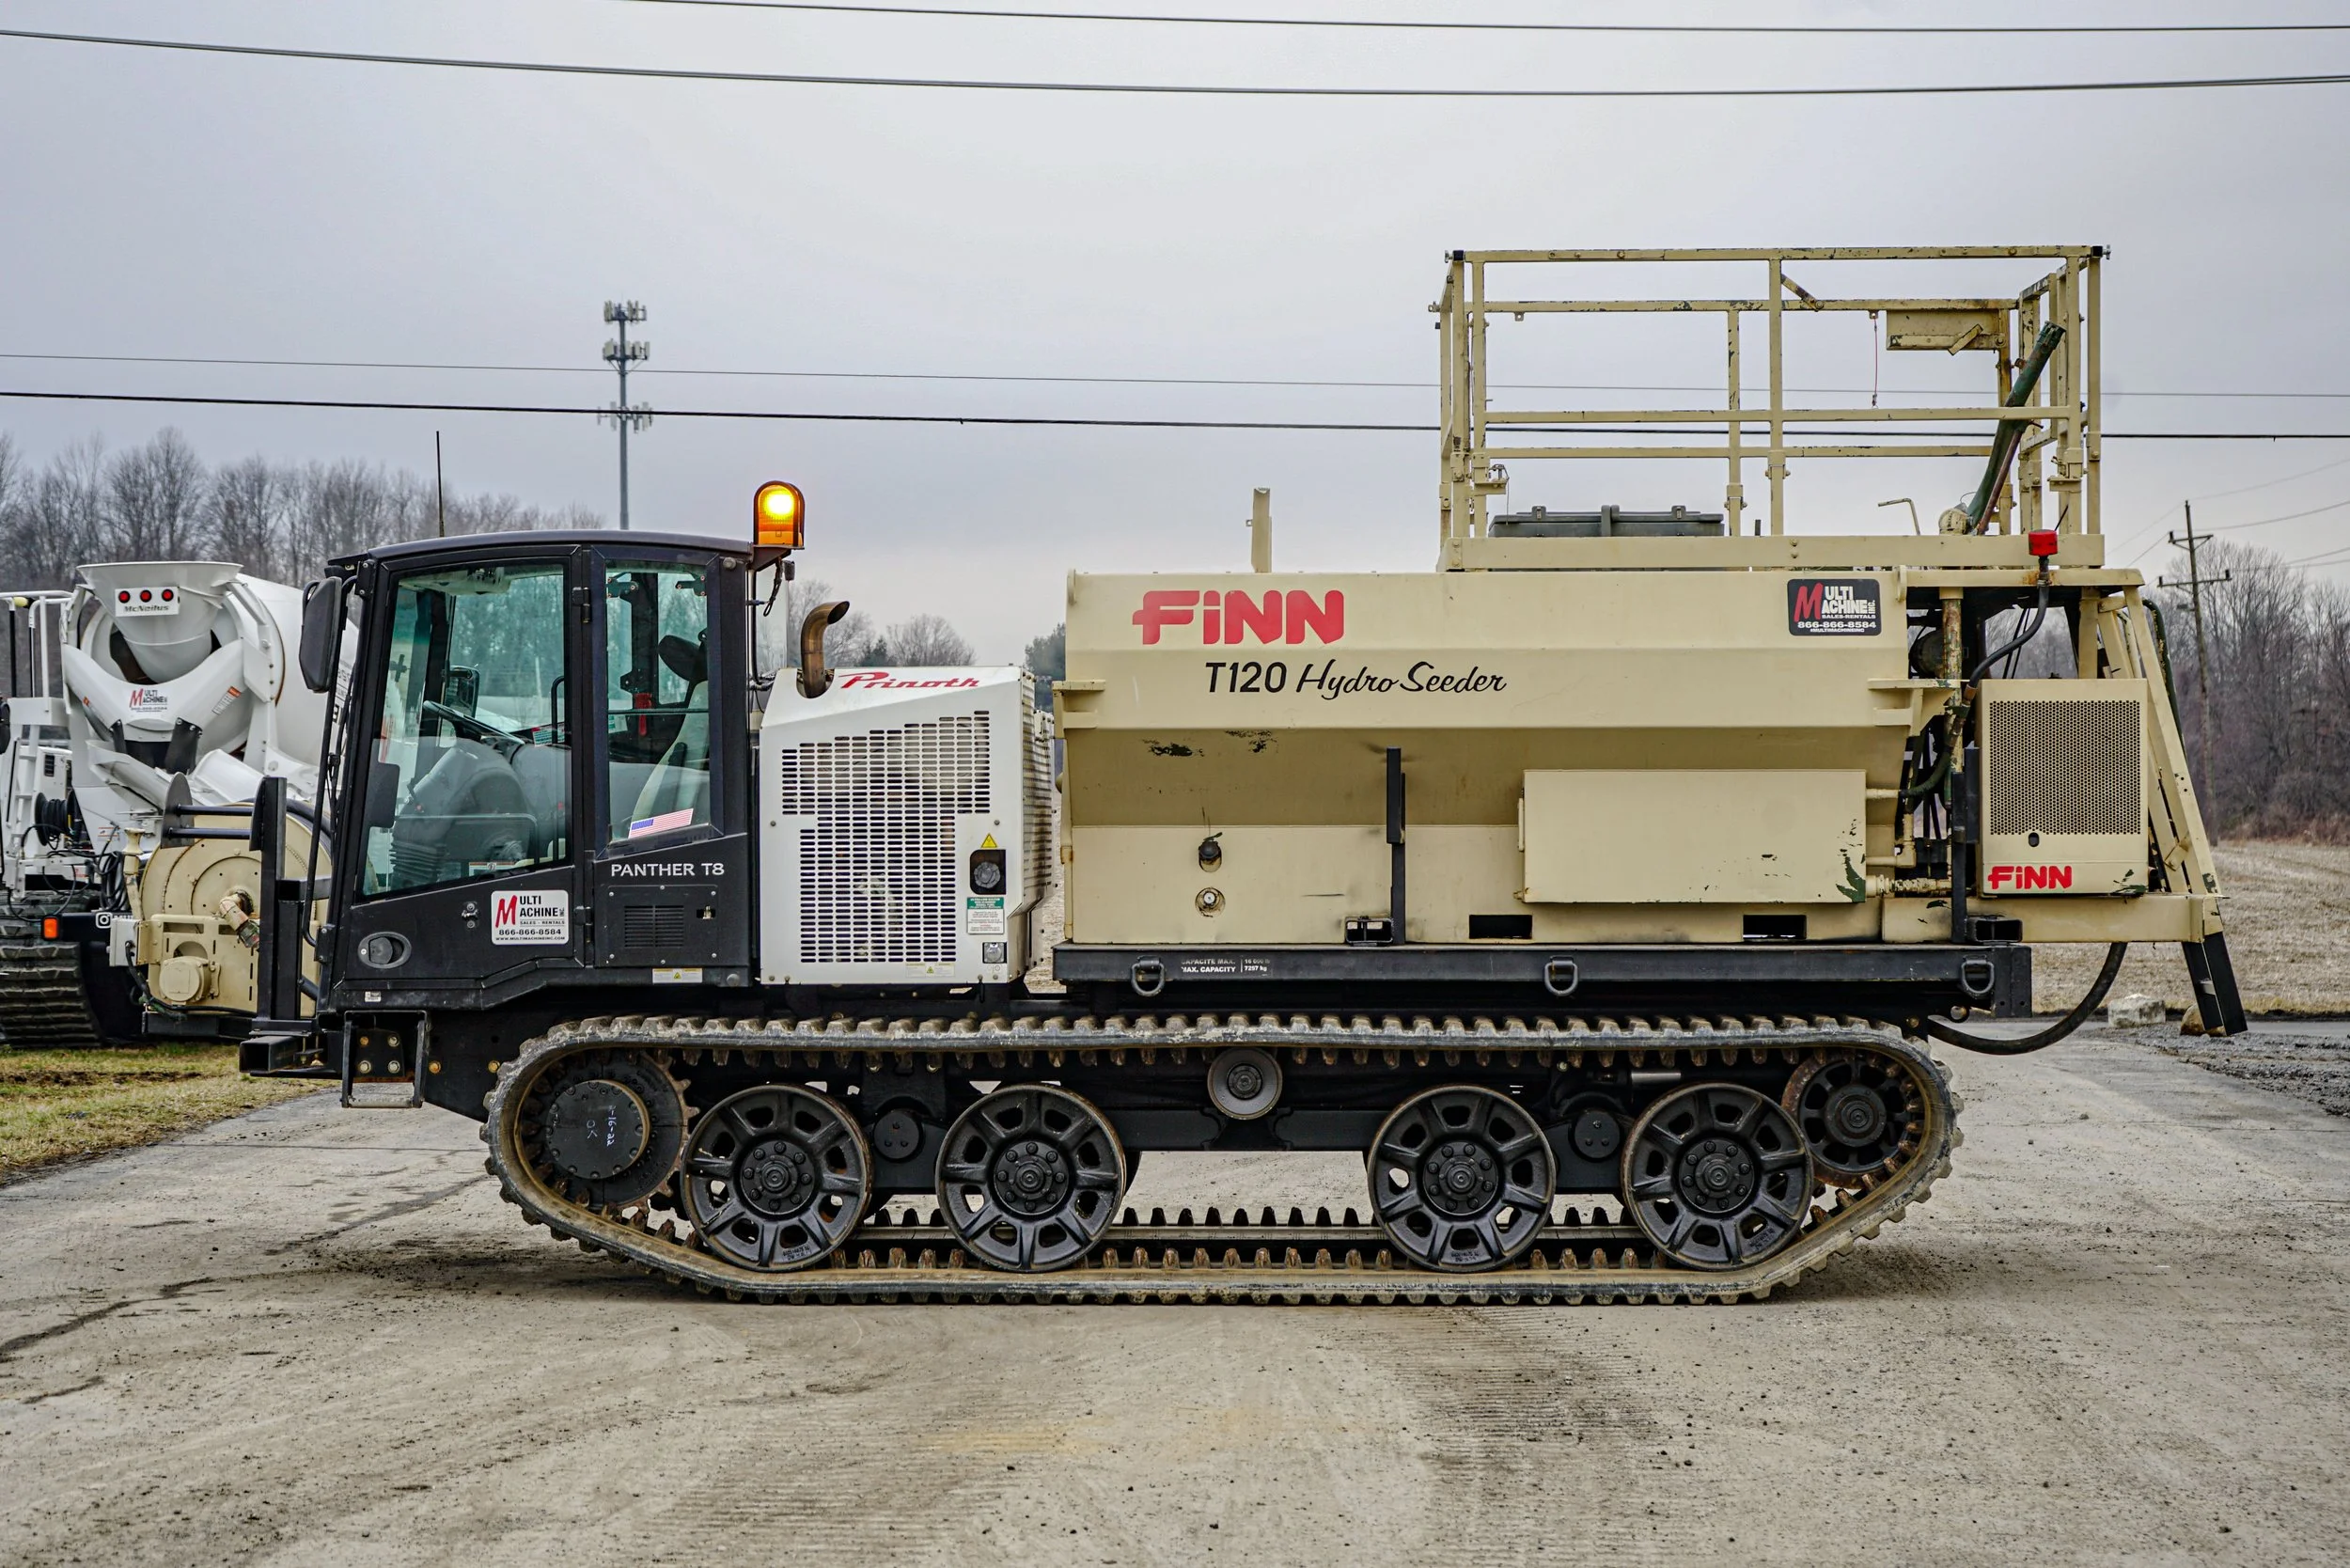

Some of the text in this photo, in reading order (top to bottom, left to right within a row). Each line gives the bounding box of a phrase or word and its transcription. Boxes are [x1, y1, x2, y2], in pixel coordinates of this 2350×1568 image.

[1797, 620, 1877, 629] 866-866-8584
[838, 671, 980, 689] Prinoth
[1205, 661, 1288, 694] T120
[611, 863, 725, 877] PANTHER T8
[498, 928, 561, 936] 866-866-8584
